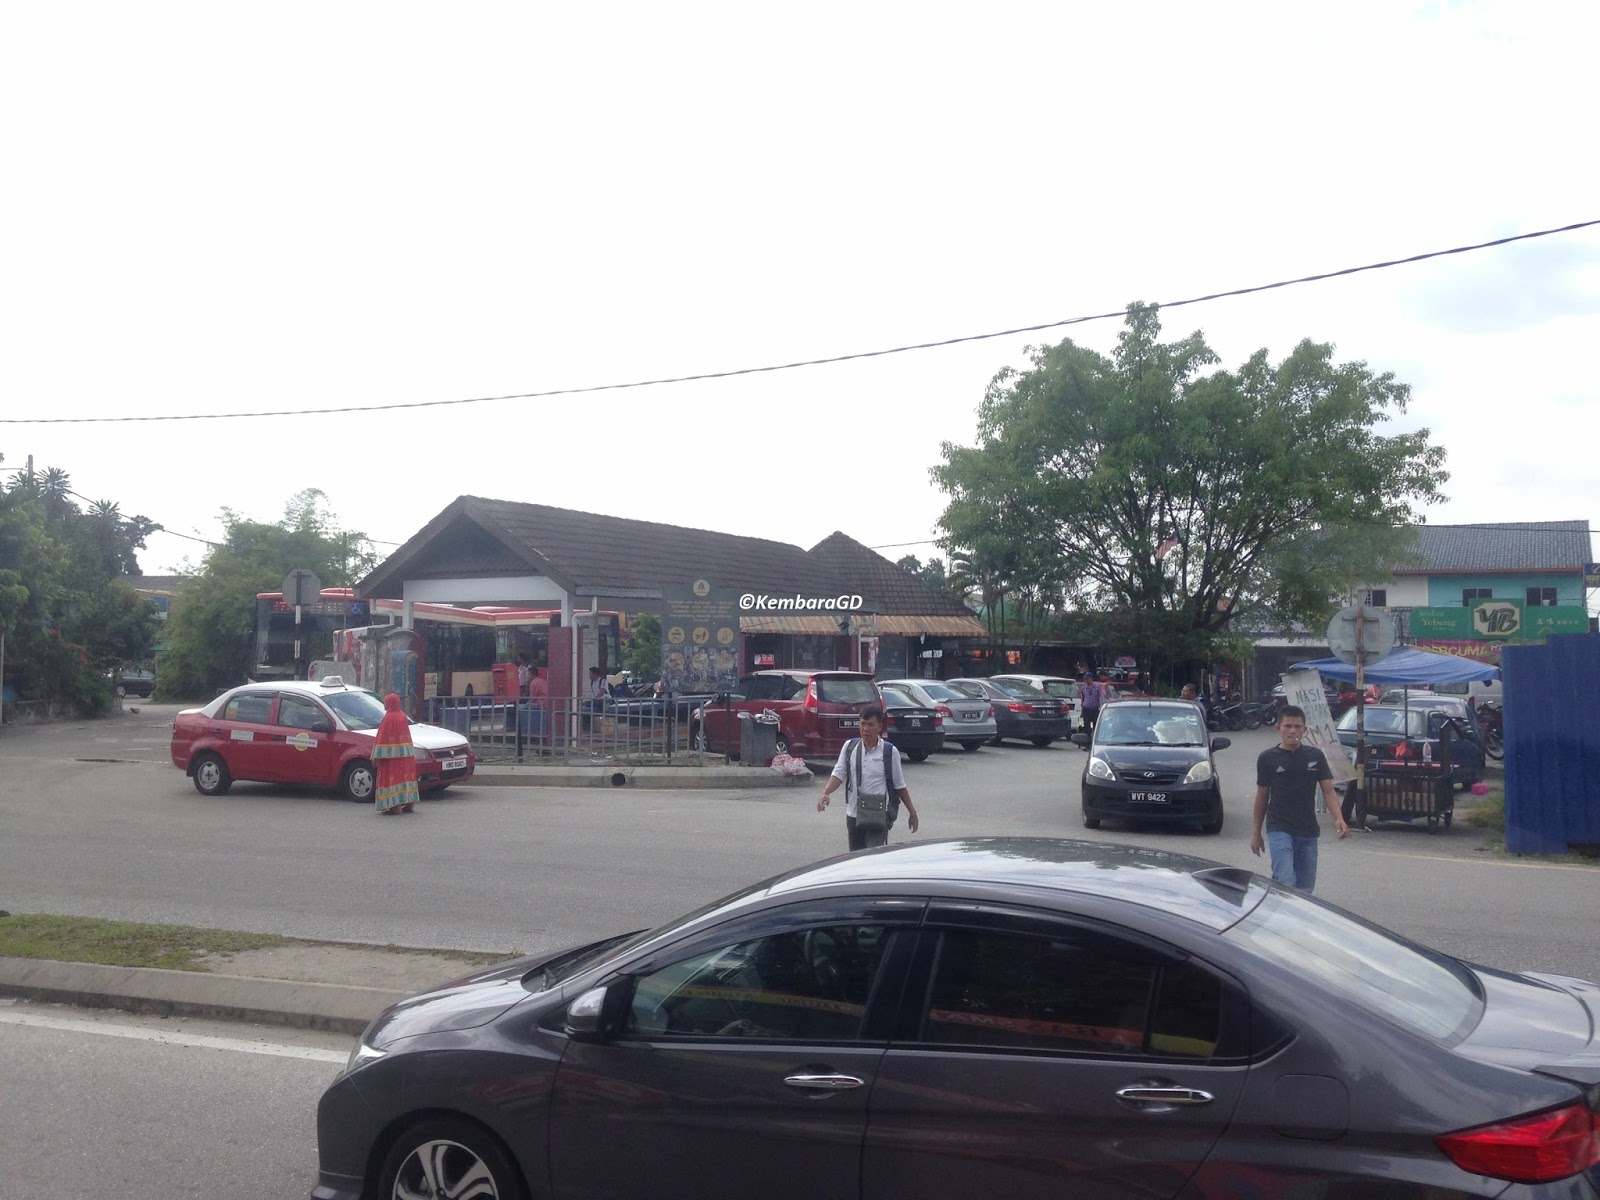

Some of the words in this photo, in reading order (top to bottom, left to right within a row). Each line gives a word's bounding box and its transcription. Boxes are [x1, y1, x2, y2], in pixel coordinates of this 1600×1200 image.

[1295, 688, 1322, 704] NASI
[1303, 703, 1330, 719] EMAK
[1131, 792, 1146, 801] WVT
[1147, 793, 1166, 802] 9422
